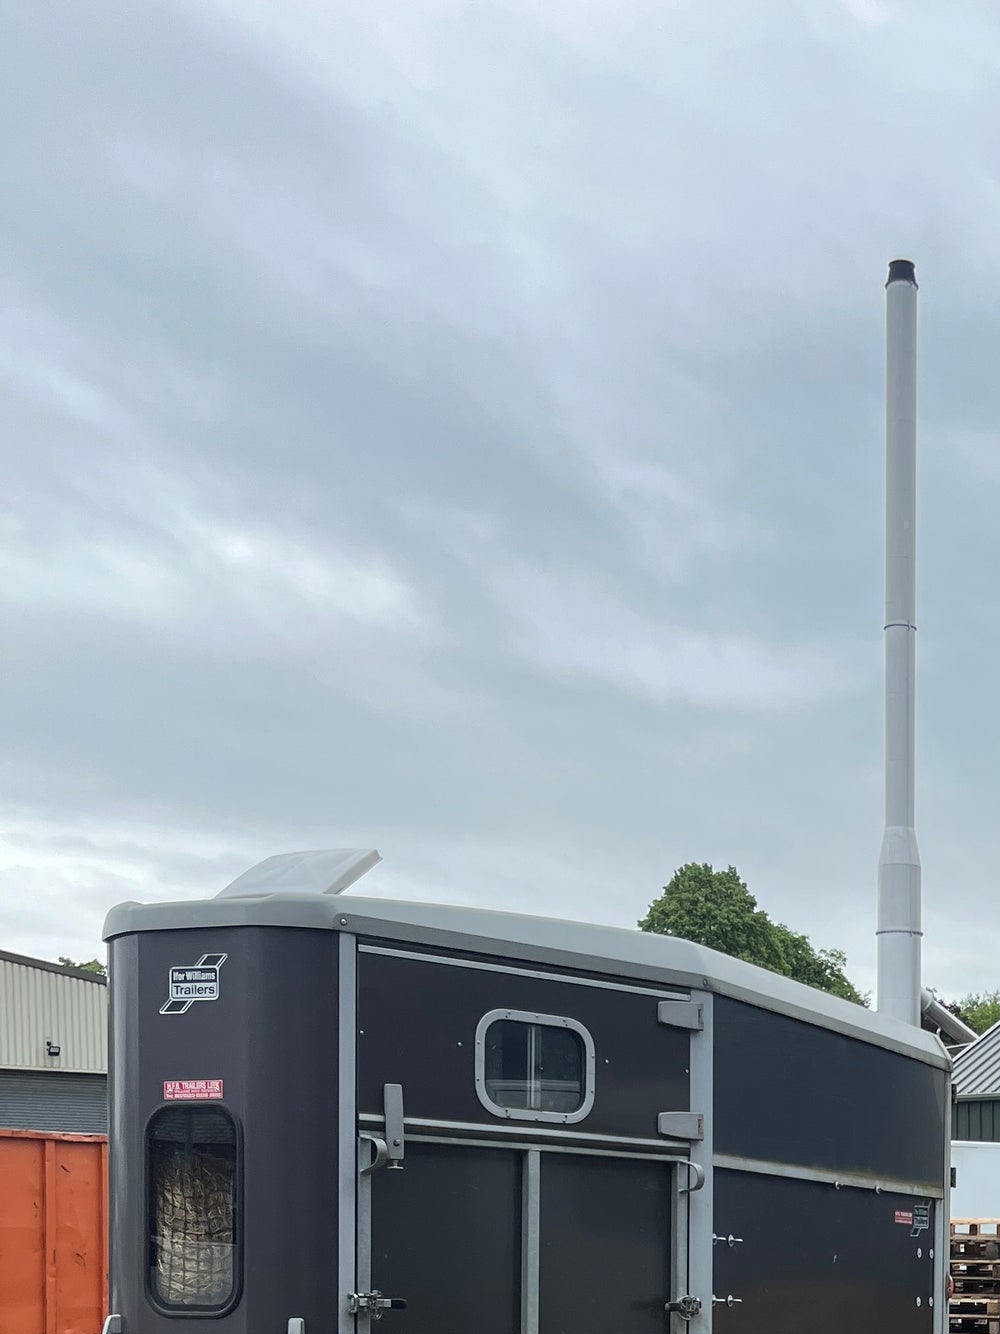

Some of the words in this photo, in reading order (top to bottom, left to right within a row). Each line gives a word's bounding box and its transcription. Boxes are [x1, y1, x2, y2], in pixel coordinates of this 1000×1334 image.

[173, 971, 185, 981] Ifor
[185, 971, 216, 981] Williams
[173, 984, 216, 995] Trailers
